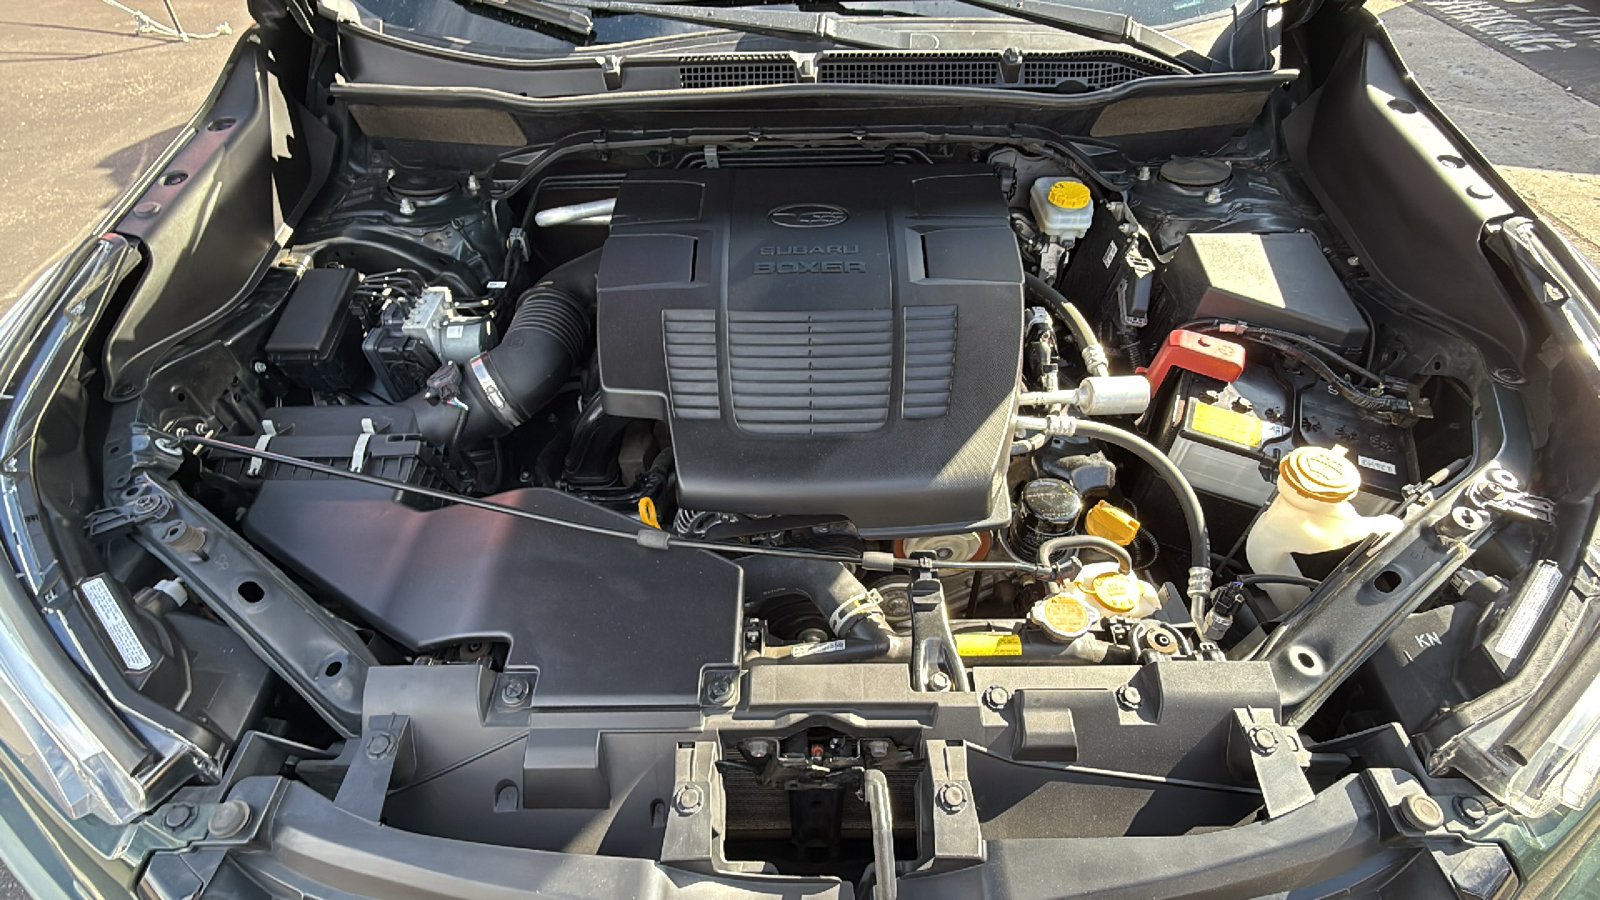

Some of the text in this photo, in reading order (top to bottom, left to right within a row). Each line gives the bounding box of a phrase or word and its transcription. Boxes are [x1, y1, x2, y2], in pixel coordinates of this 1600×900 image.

[760, 244, 859, 255] SUBARU
[752, 261, 866, 274] BOXER
[1414, 631, 1442, 648] KN
